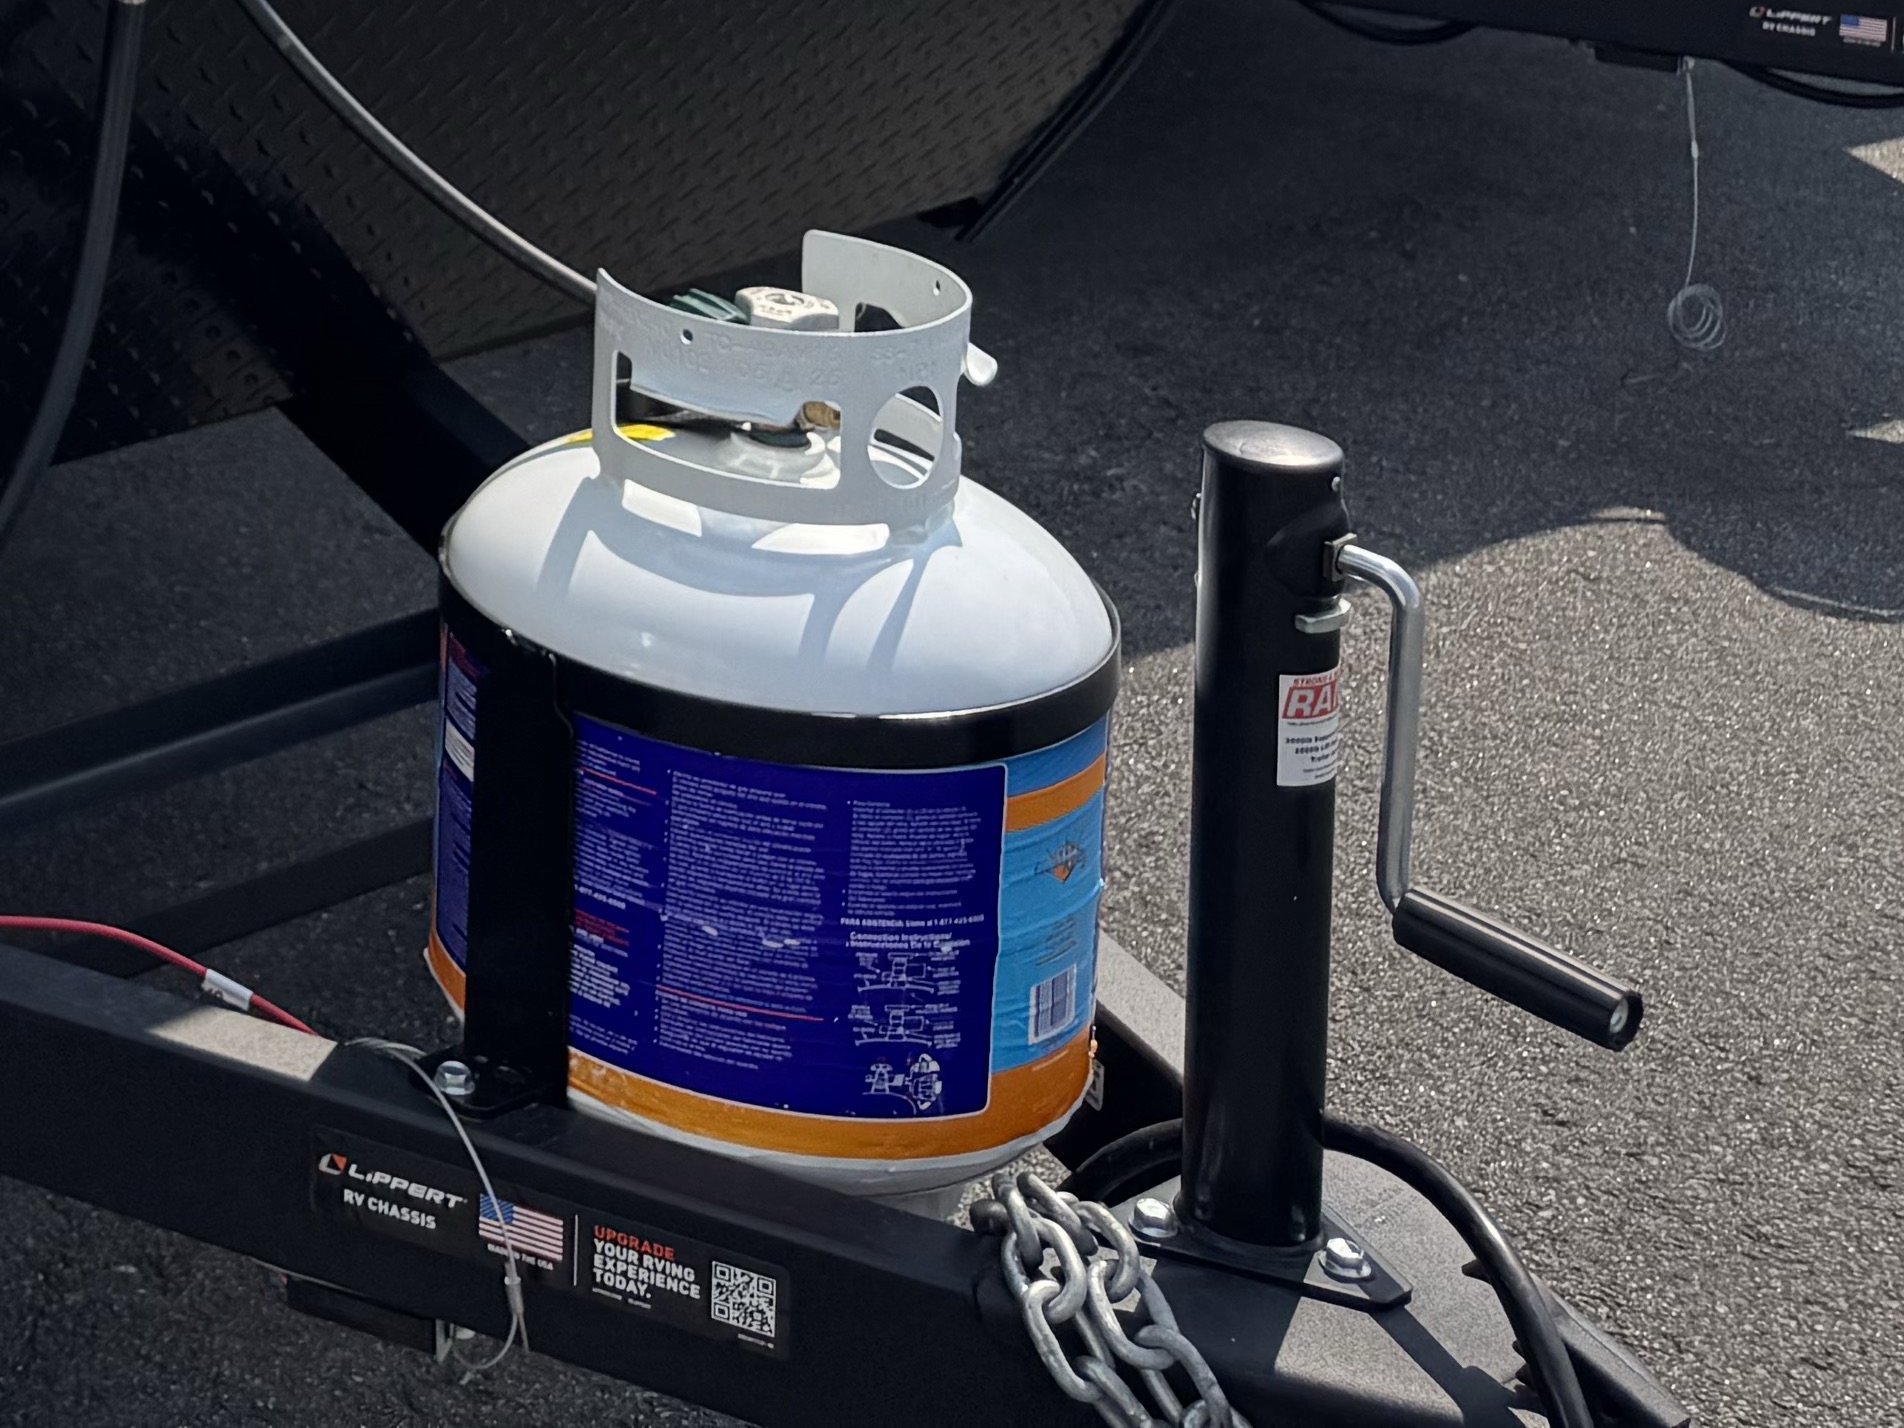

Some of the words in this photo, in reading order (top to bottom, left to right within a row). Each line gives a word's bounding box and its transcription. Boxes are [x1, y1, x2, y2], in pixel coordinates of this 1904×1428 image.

[1286, 682, 1338, 718] RA
[348, 1163, 464, 1208] LIPPERT
[343, 1188, 365, 1206] RV
[367, 1196, 436, 1229] CHASSIS
[594, 1224, 675, 1261] UPGRADE
[594, 1238, 639, 1265] YOUR
[642, 1254, 695, 1282] RVING
[593, 1253, 701, 1299] EXPERIENCE
[593, 1267, 651, 1299] TODAY.
